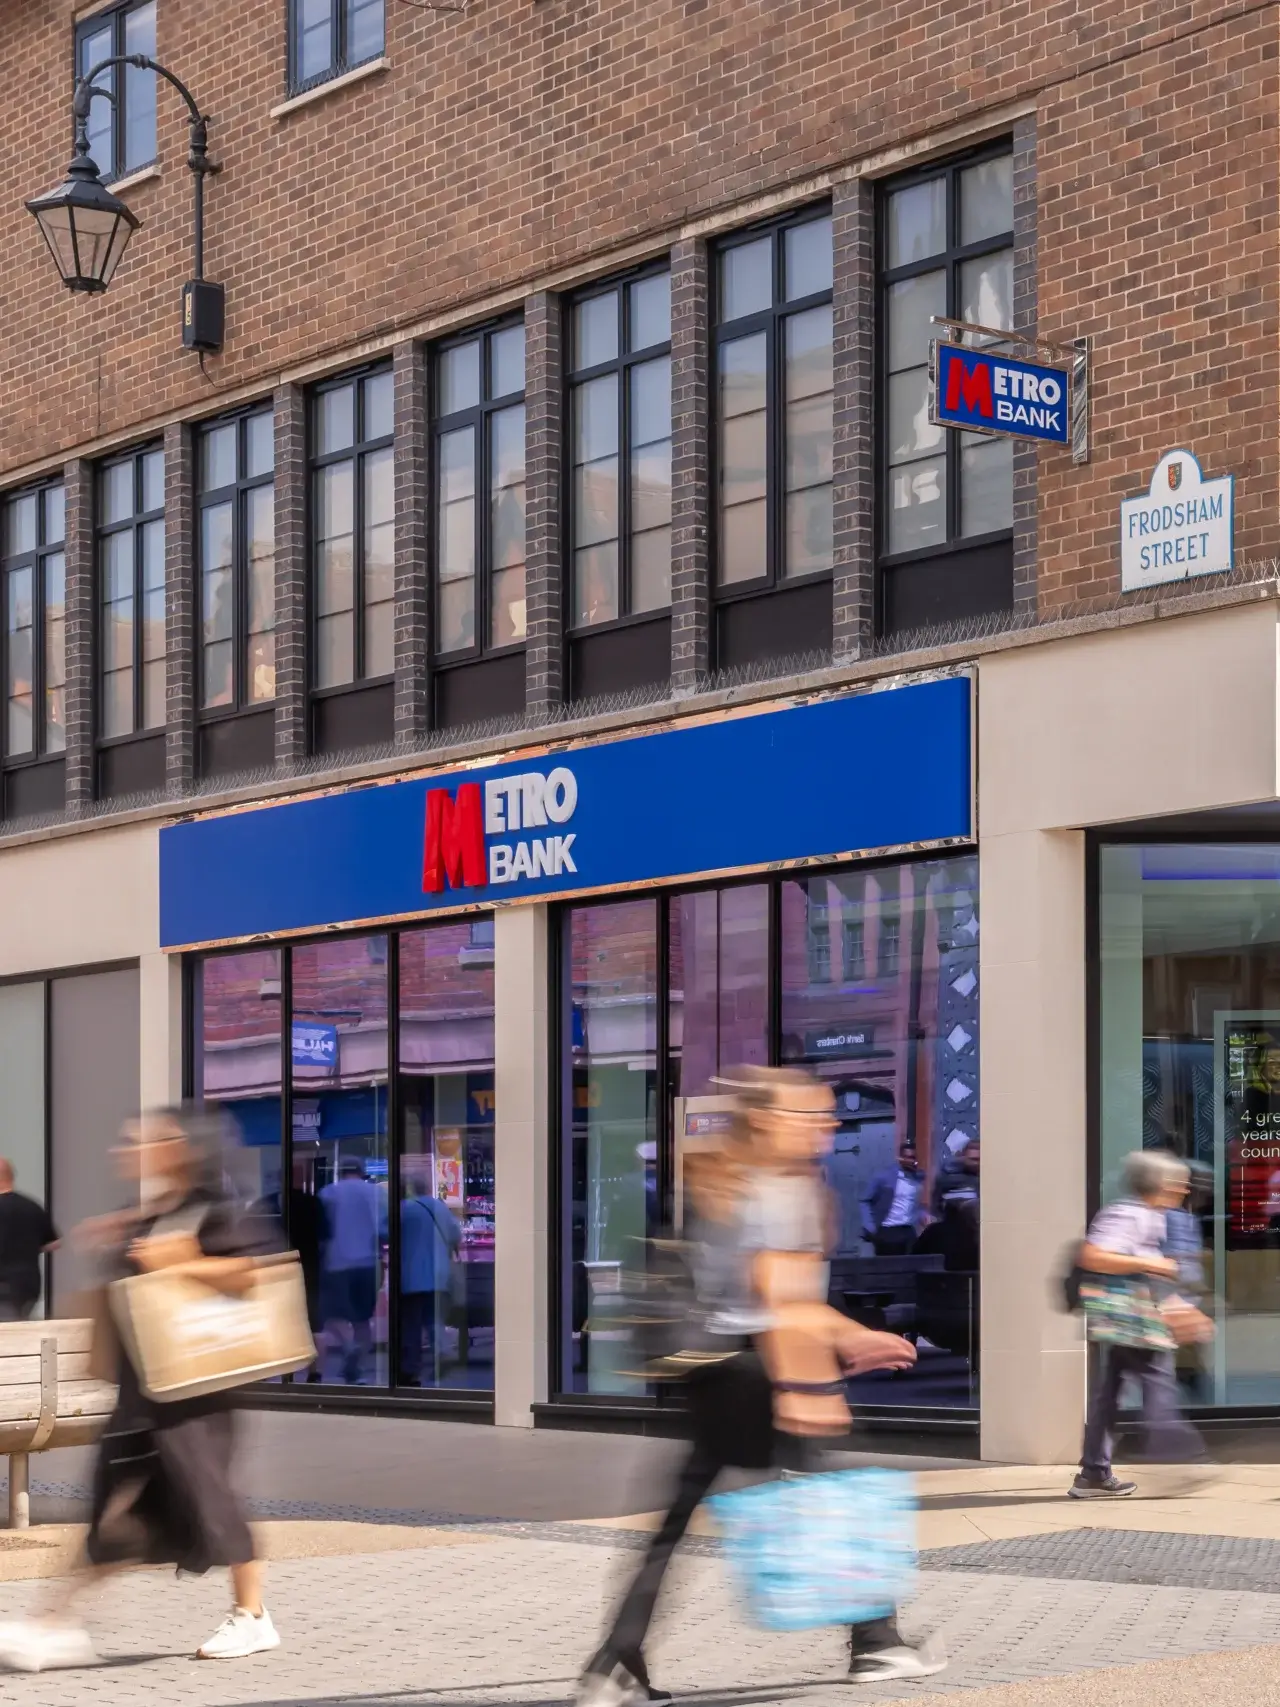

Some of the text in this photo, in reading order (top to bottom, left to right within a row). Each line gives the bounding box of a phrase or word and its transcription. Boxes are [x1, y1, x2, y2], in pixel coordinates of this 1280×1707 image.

[945, 357, 1061, 418] METRO
[997, 400, 1061, 432] BANK
[1129, 493, 1223, 538] FRODSHAM
[1140, 532, 1209, 570] STREET
[422, 767, 578, 893] METRO
[489, 834, 578, 884] BANK
[1240, 1109, 1252, 1123] 4
